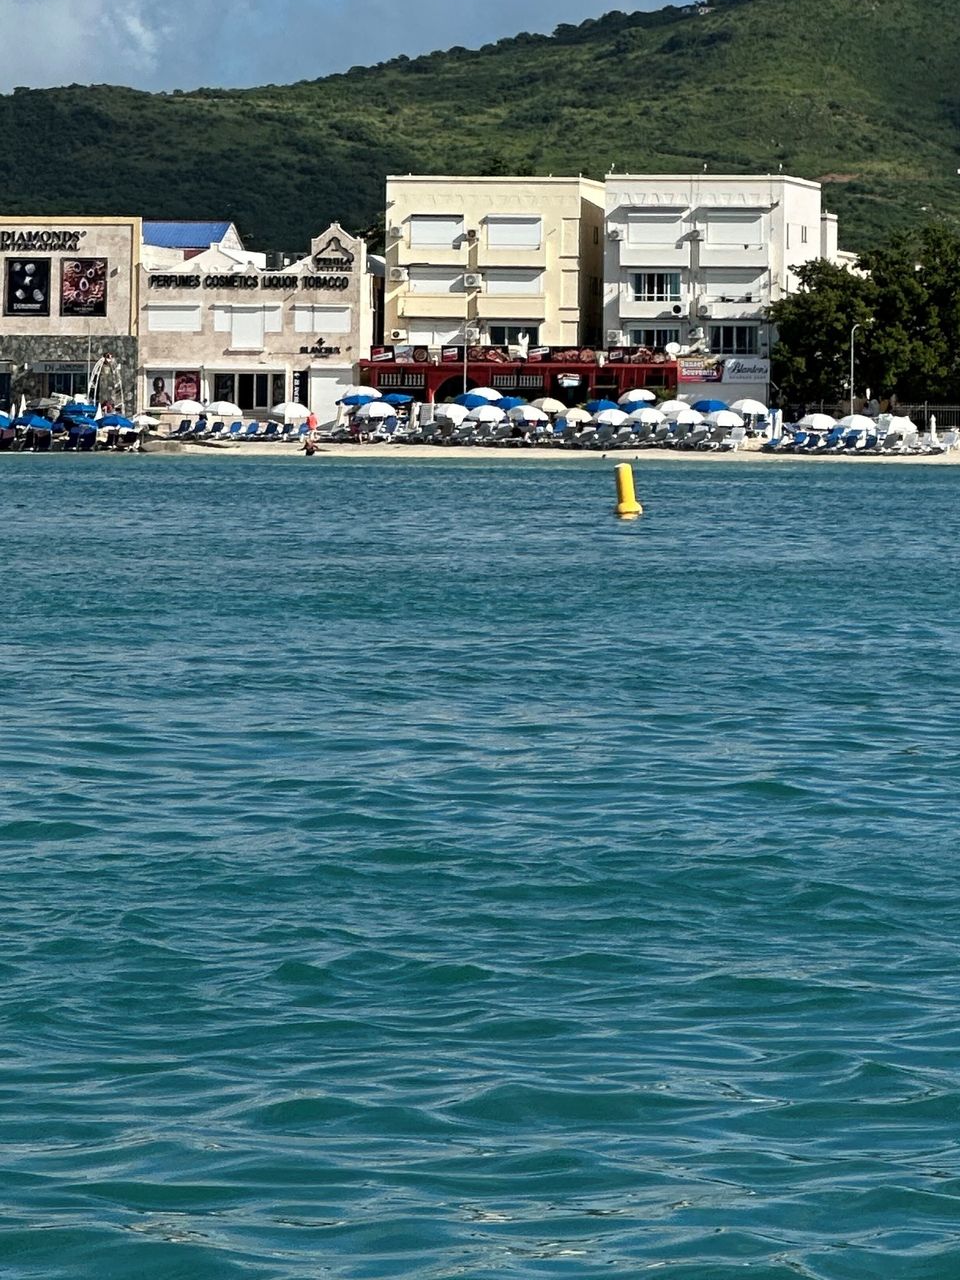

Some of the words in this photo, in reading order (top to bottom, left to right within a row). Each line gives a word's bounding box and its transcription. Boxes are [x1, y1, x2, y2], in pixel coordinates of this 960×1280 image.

[0, 230, 80, 243] DIAMONDS
[0, 242, 81, 251] INTERNATIONAL
[149, 274, 201, 288] PERFUMES
[204, 275, 259, 289] COSMETICS
[261, 275, 299, 289] LIQUOR
[302, 275, 350, 290] TOBACCO
